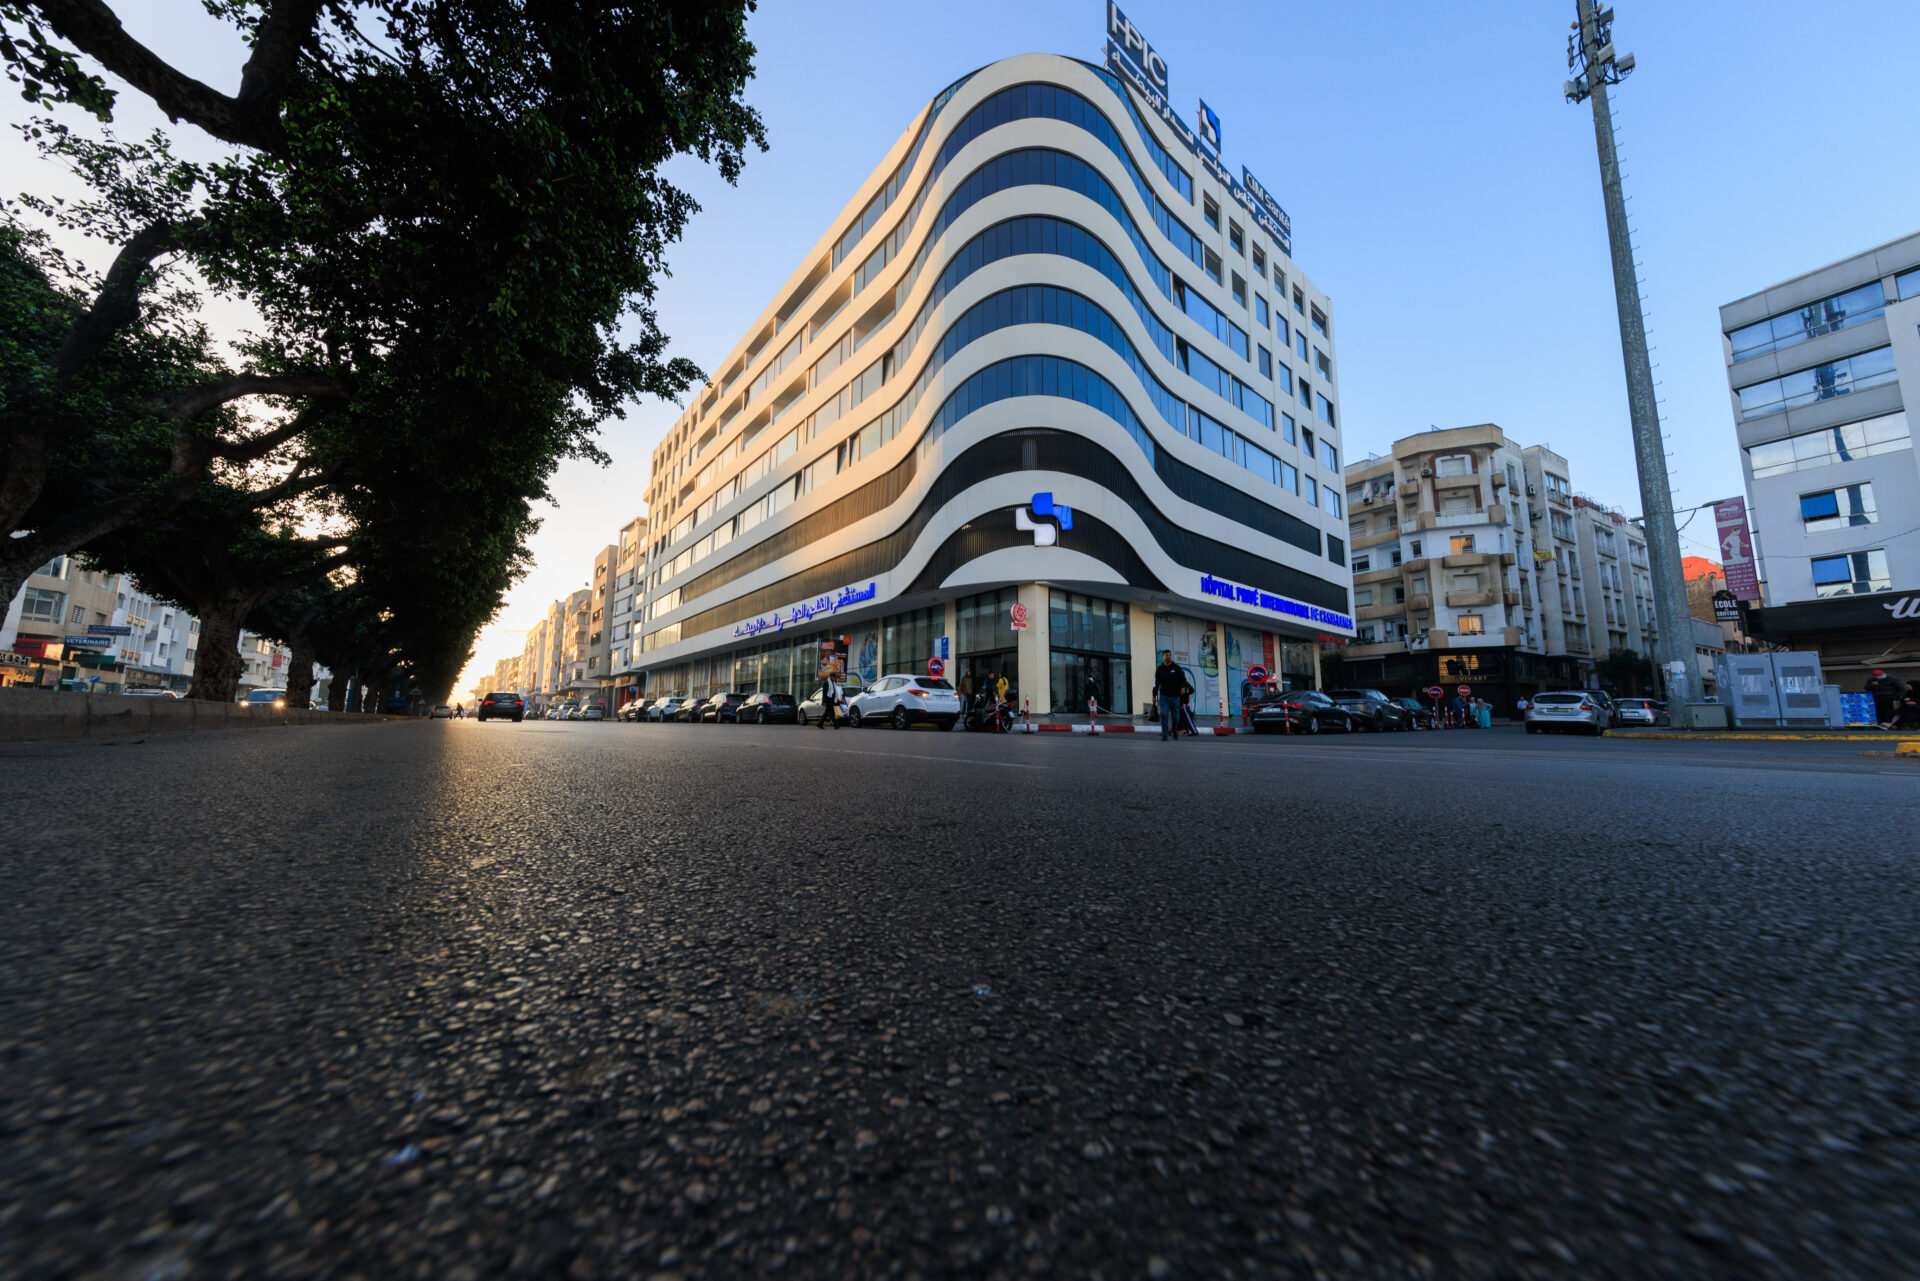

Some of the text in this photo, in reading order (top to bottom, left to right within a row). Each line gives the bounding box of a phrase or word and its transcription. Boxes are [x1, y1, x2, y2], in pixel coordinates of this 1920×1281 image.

[1111, 2, 1166, 87] HPIC
[1197, 147, 1231, 185] الدولي
[1233, 187, 1256, 213] الخاص
[1245, 172, 1290, 230] CIM Santé
[1258, 214, 1290, 250] المستشفى
[806, 595, 830, 620] الخاص
[830, 582, 876, 614] المستشفى
[1200, 574, 1353, 630] HÔPITAL PRIVÉ INTERNATIONAL DE CASABLANCA
[777, 603, 806, 632] الدولي
